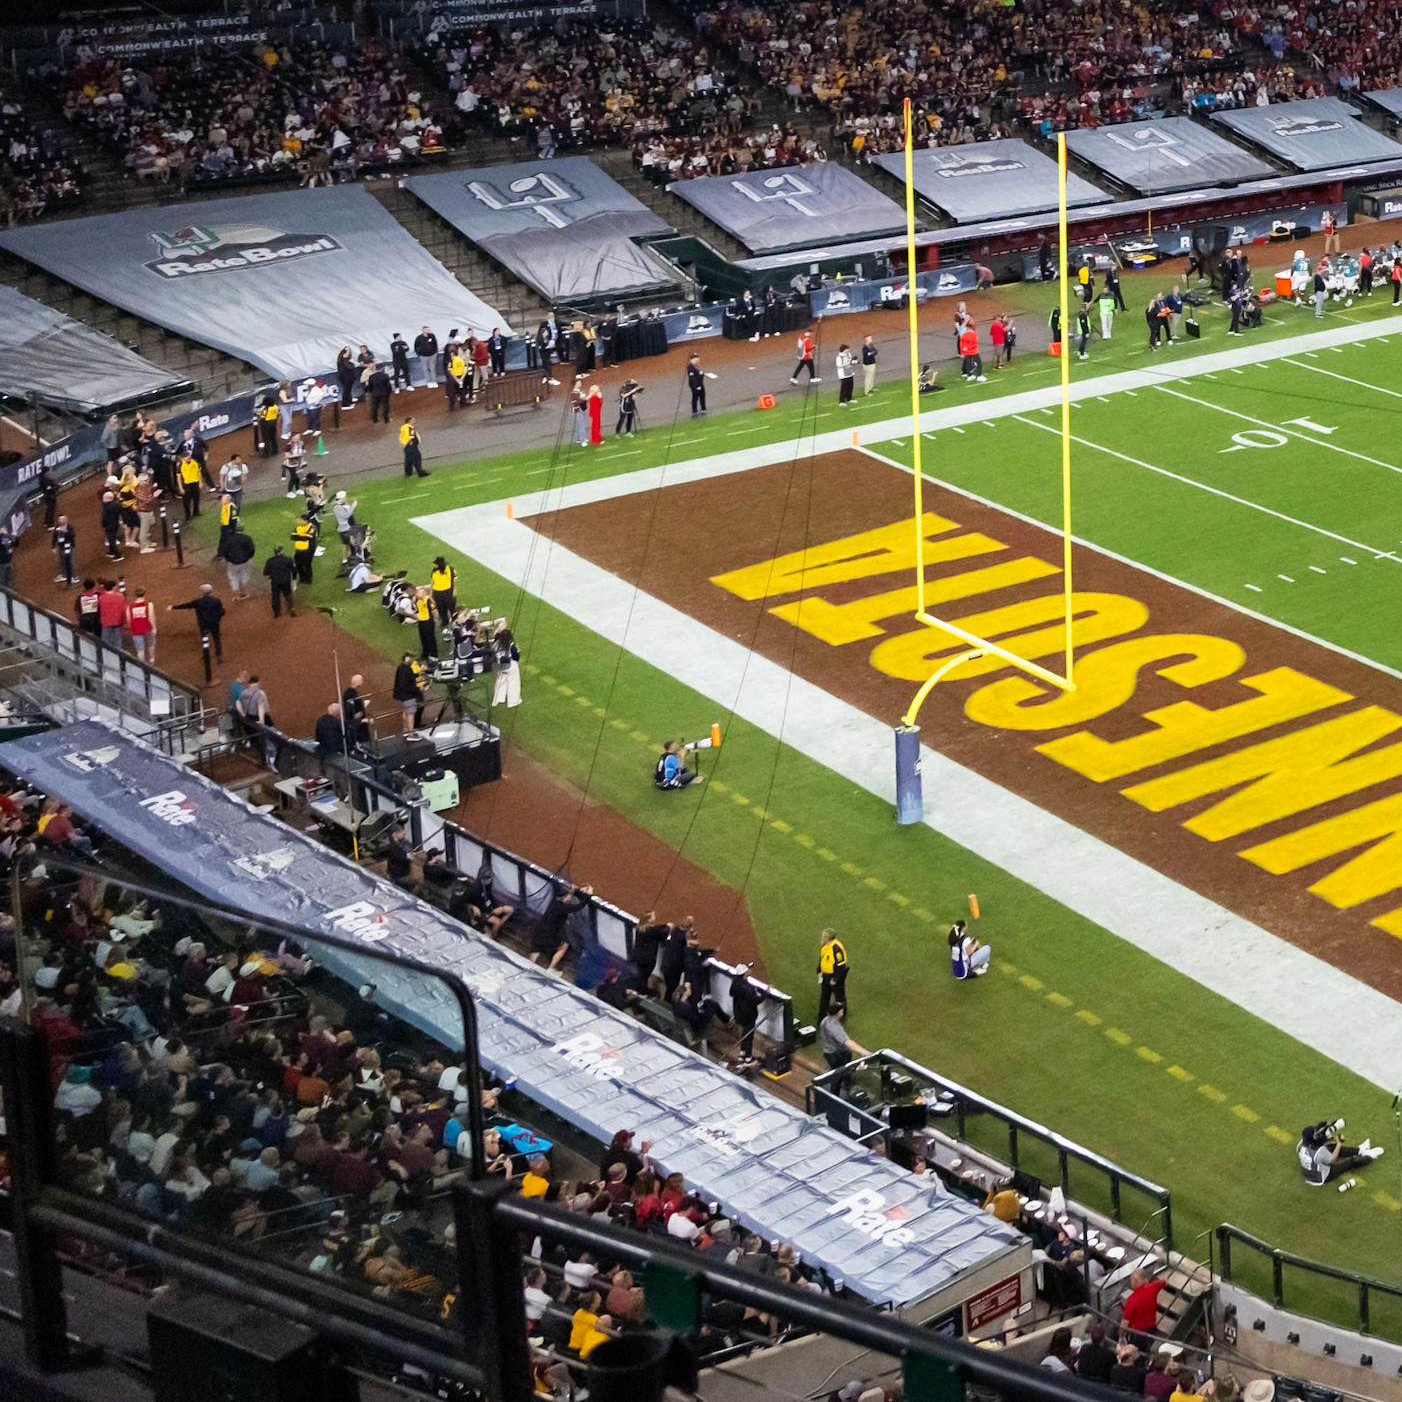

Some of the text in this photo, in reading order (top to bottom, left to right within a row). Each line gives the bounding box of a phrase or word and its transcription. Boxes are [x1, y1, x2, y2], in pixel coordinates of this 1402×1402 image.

[550, 4, 598, 16] TERRACE
[195, 15, 250, 29] TERRACE
[212, 31, 268, 46] TERRACE
[198, 413, 230, 431] Rate
[1231, 416, 1338, 451] 10
[17, 461, 43, 485] RATE
[138, 790, 198, 826] Rate
[825, 1187, 918, 1249] Rate
